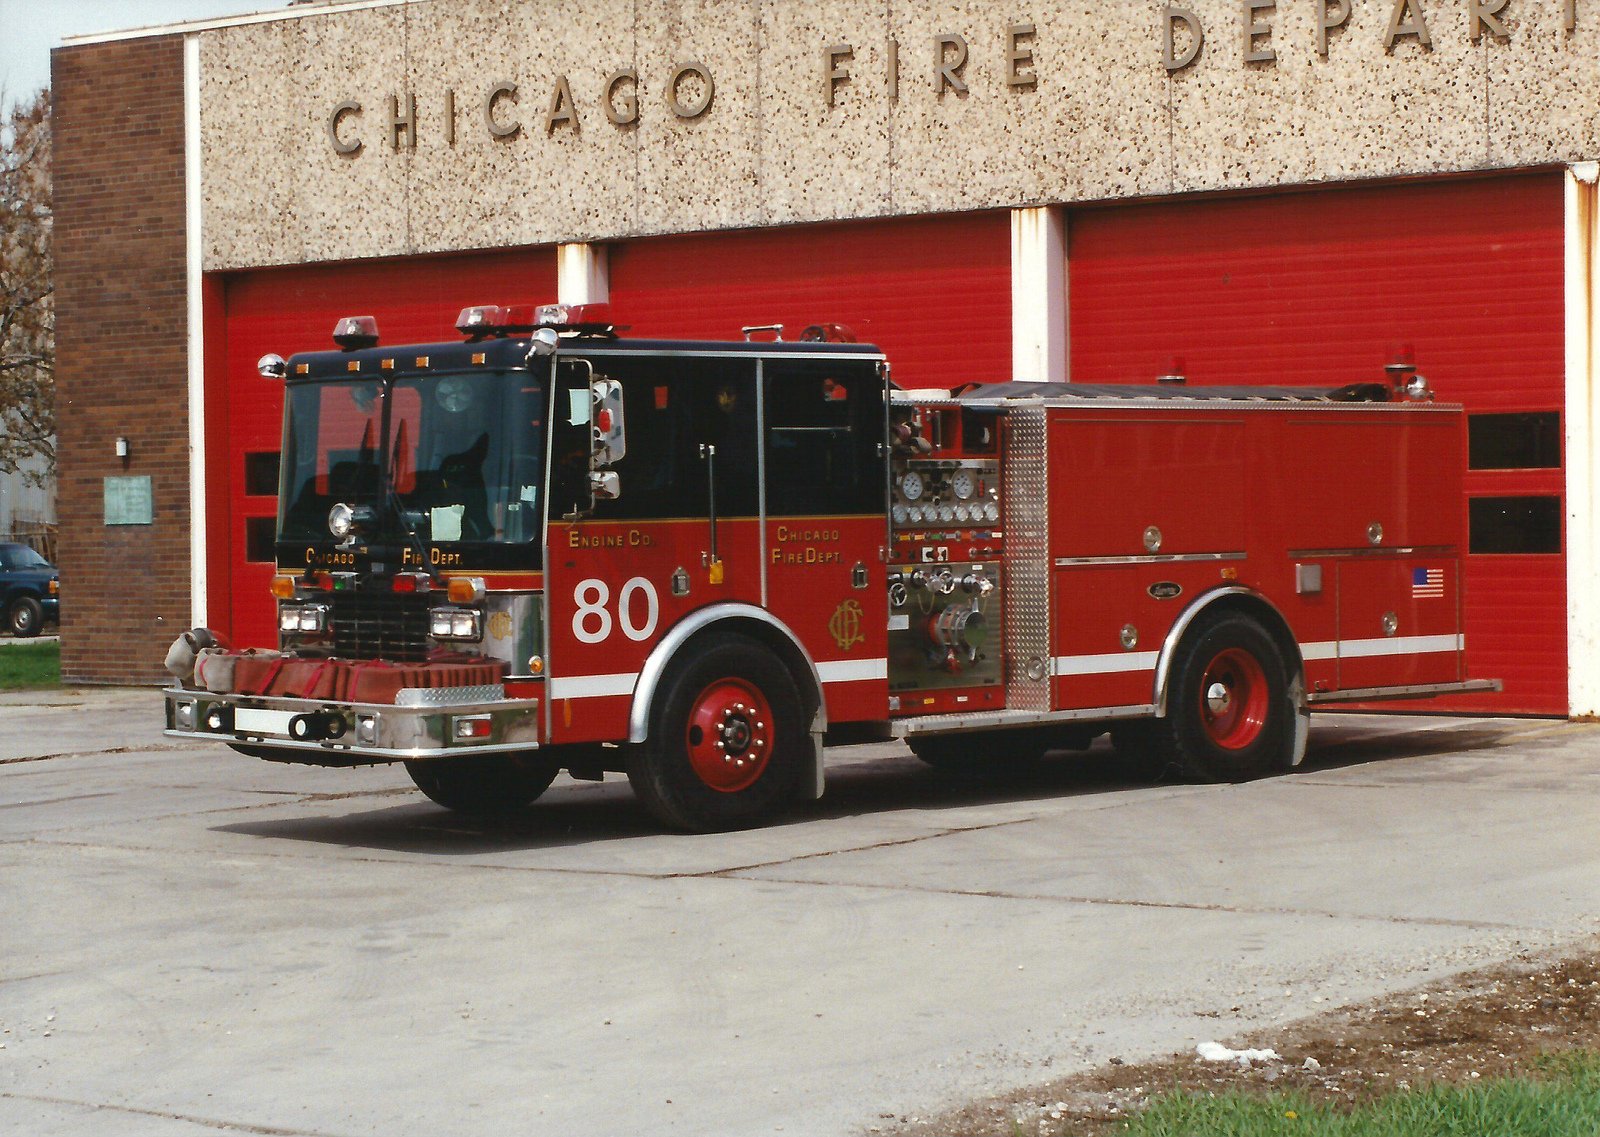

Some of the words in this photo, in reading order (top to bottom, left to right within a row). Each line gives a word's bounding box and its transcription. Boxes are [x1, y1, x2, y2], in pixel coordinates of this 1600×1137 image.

[327, 61, 716, 155] CHICAGO
[823, 23, 1037, 108] FIRE
[569, 530, 623, 548] ENGINE
[305, 547, 355, 565] CICAGO
[402, 547, 423, 565] FIR
[771, 548, 803, 565] FIRE
[571, 576, 660, 644] 80
